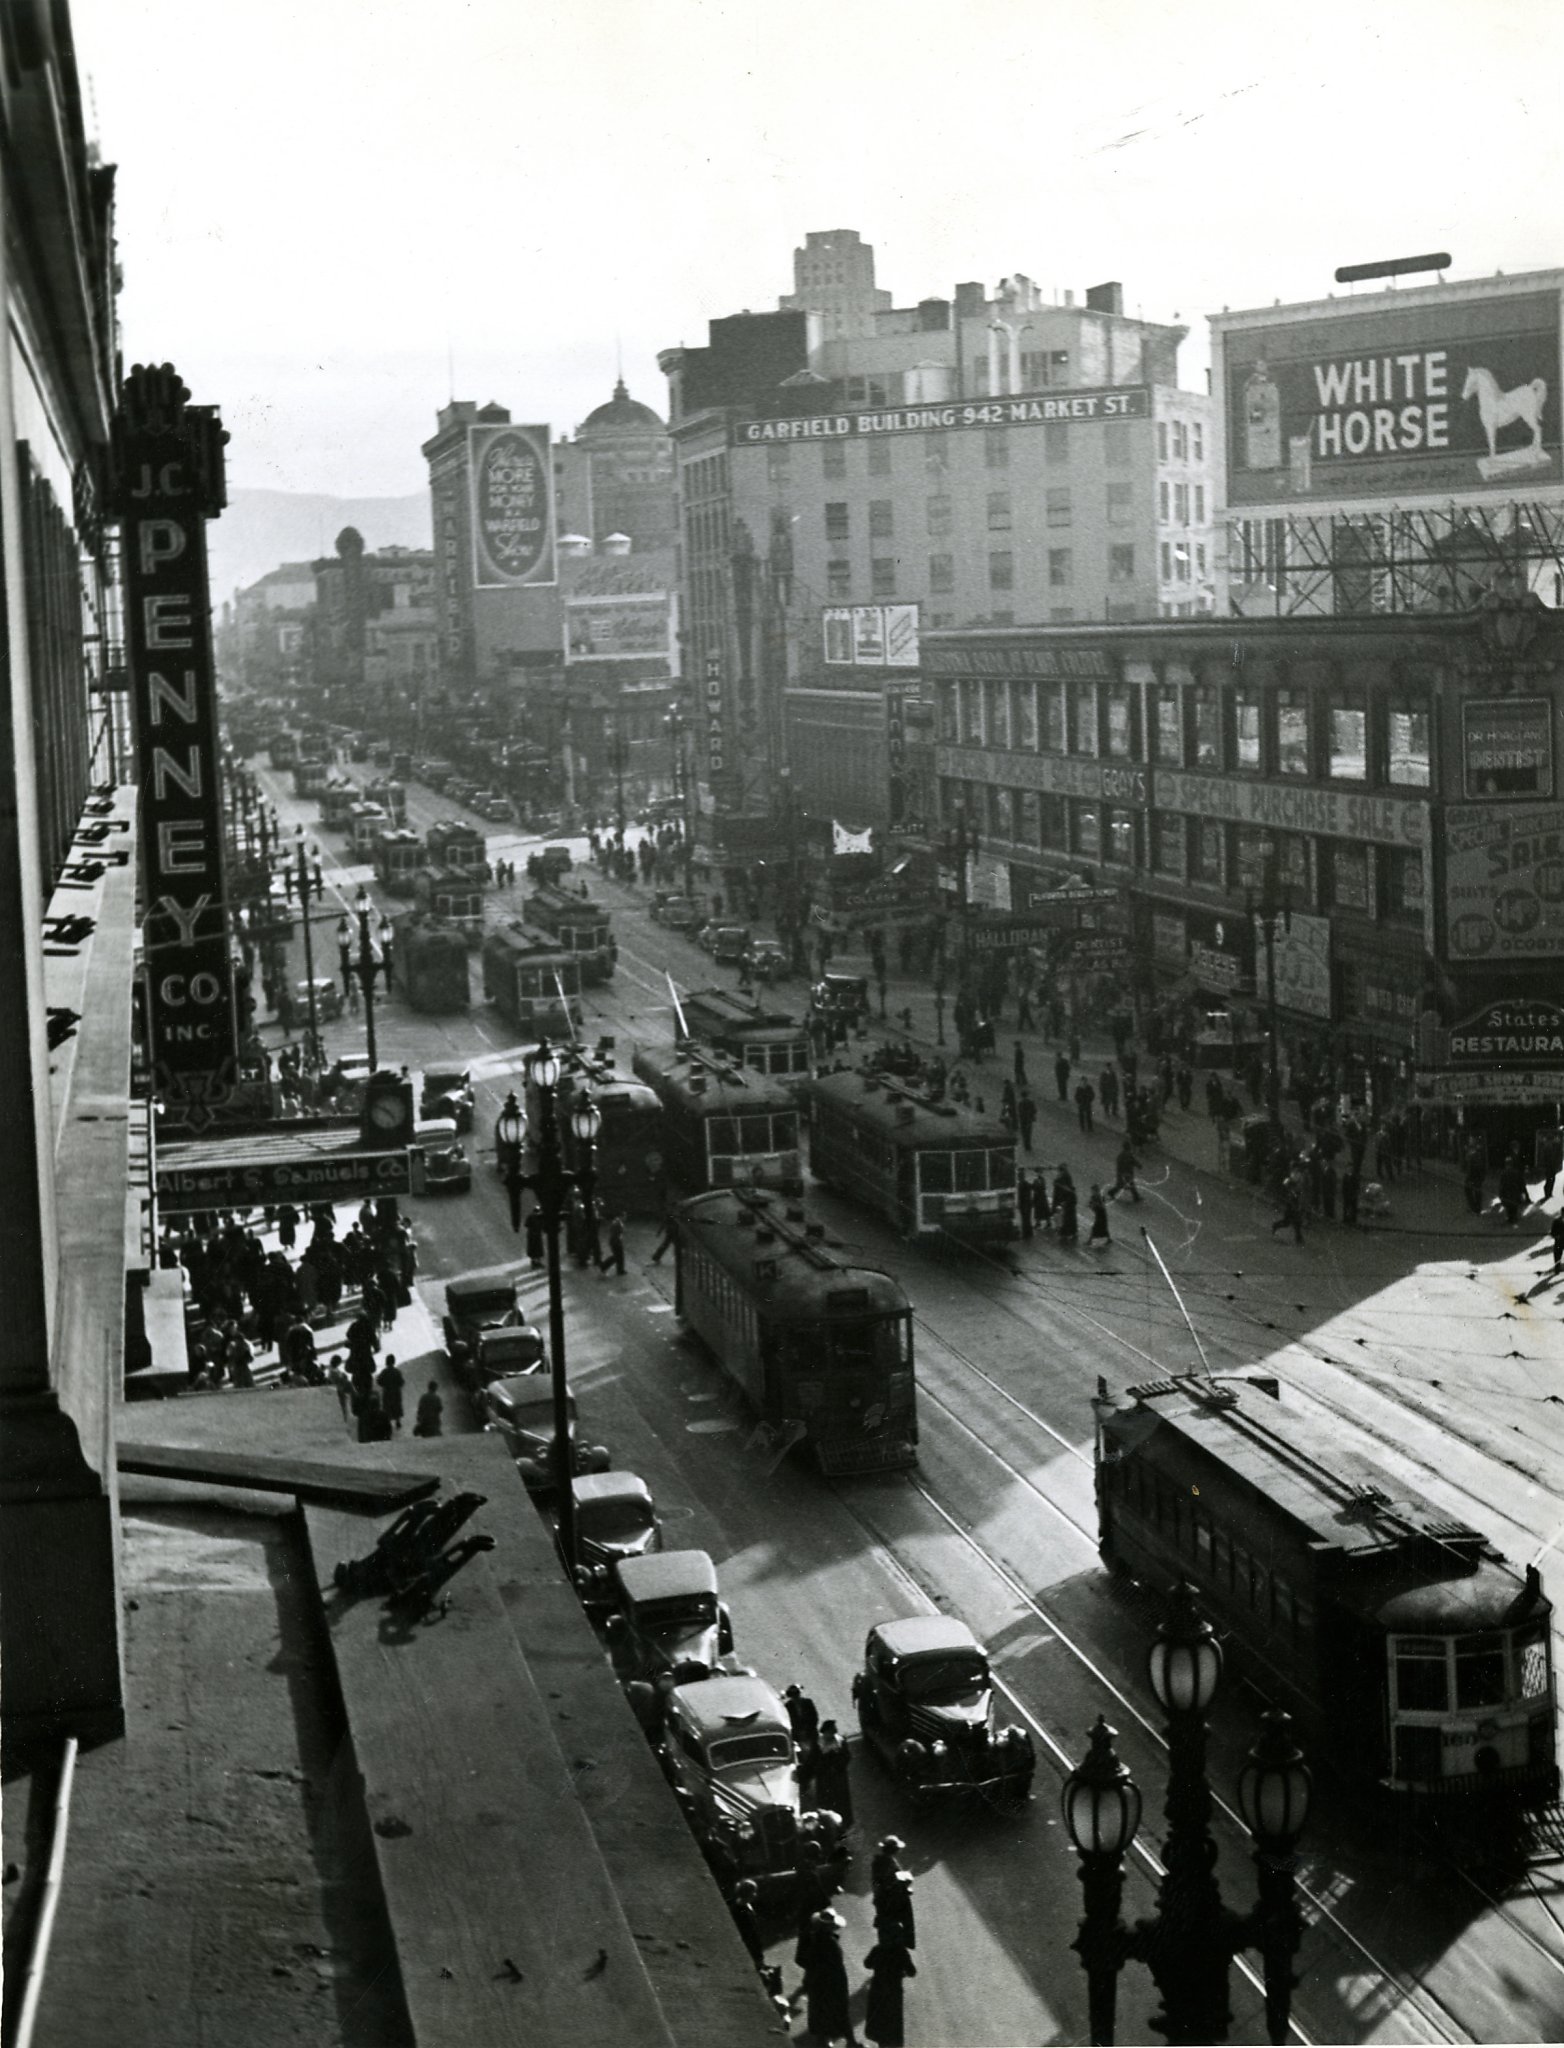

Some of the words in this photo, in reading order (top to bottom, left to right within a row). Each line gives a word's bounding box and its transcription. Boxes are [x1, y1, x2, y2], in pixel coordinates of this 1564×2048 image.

[1313, 351, 1447, 407] WHITE
[747, 416, 850, 441] GARFIELD
[857, 409, 955, 434] BUILDING
[1010, 398, 1097, 421] MARKET
[1104, 394, 1136, 415] ST.
[1317, 404, 1449, 456] HORSE
[137, 519, 212, 947] PENNEY
[706, 663, 723, 770] HOWARD
[1470, 747, 1546, 770] DENTIST
[1250, 784, 1339, 832] PURCHASE
[1347, 797, 1395, 841] SALE
[160, 972, 228, 1007] CO.
[1487, 1010, 1560, 1027] States
[156, 1169, 236, 1193] Albert
[272, 1158, 370, 1187] Samuels
